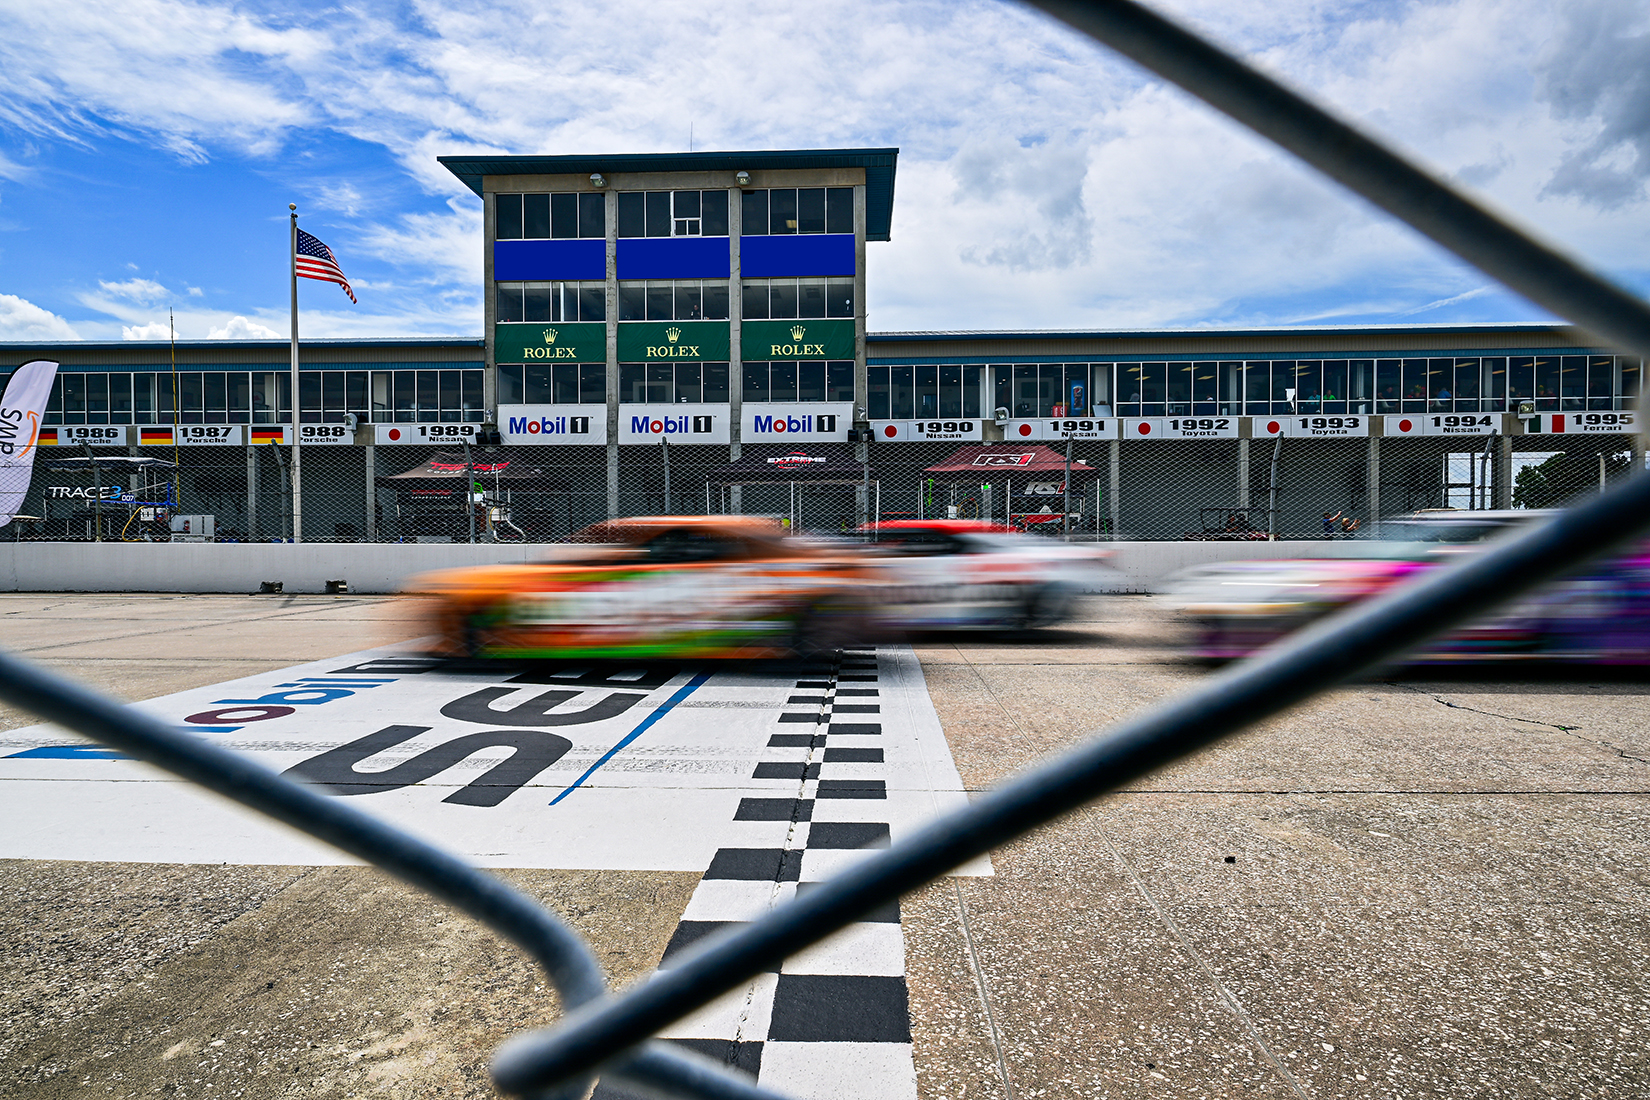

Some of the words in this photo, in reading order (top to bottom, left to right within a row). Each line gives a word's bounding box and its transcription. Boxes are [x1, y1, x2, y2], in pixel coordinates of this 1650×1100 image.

[523, 347, 577, 359] ROLEX
[646, 346, 700, 357] ROLEX
[771, 345, 825, 356] ROLEX
[509, 416, 566, 434] Mobil
[631, 415, 689, 433] Mobil
[754, 414, 812, 433] Mobil
[1169, 418, 1230, 431] 1992
[1299, 417, 1360, 429] 1993
[1430, 415, 1493, 427] 1994
[1573, 413, 1634, 425] 1995
[179, 426, 233, 438] 1987
[290, 426, 346, 437] 988
[417, 425, 475, 437] 1989
[914, 421, 974, 434] 1990
[1049, 420, 1105, 432] 1991
[1310, 428, 1348, 436] Toyota
[64, 427, 119, 439] 1986
[766, 456, 827, 464] EXTREME
